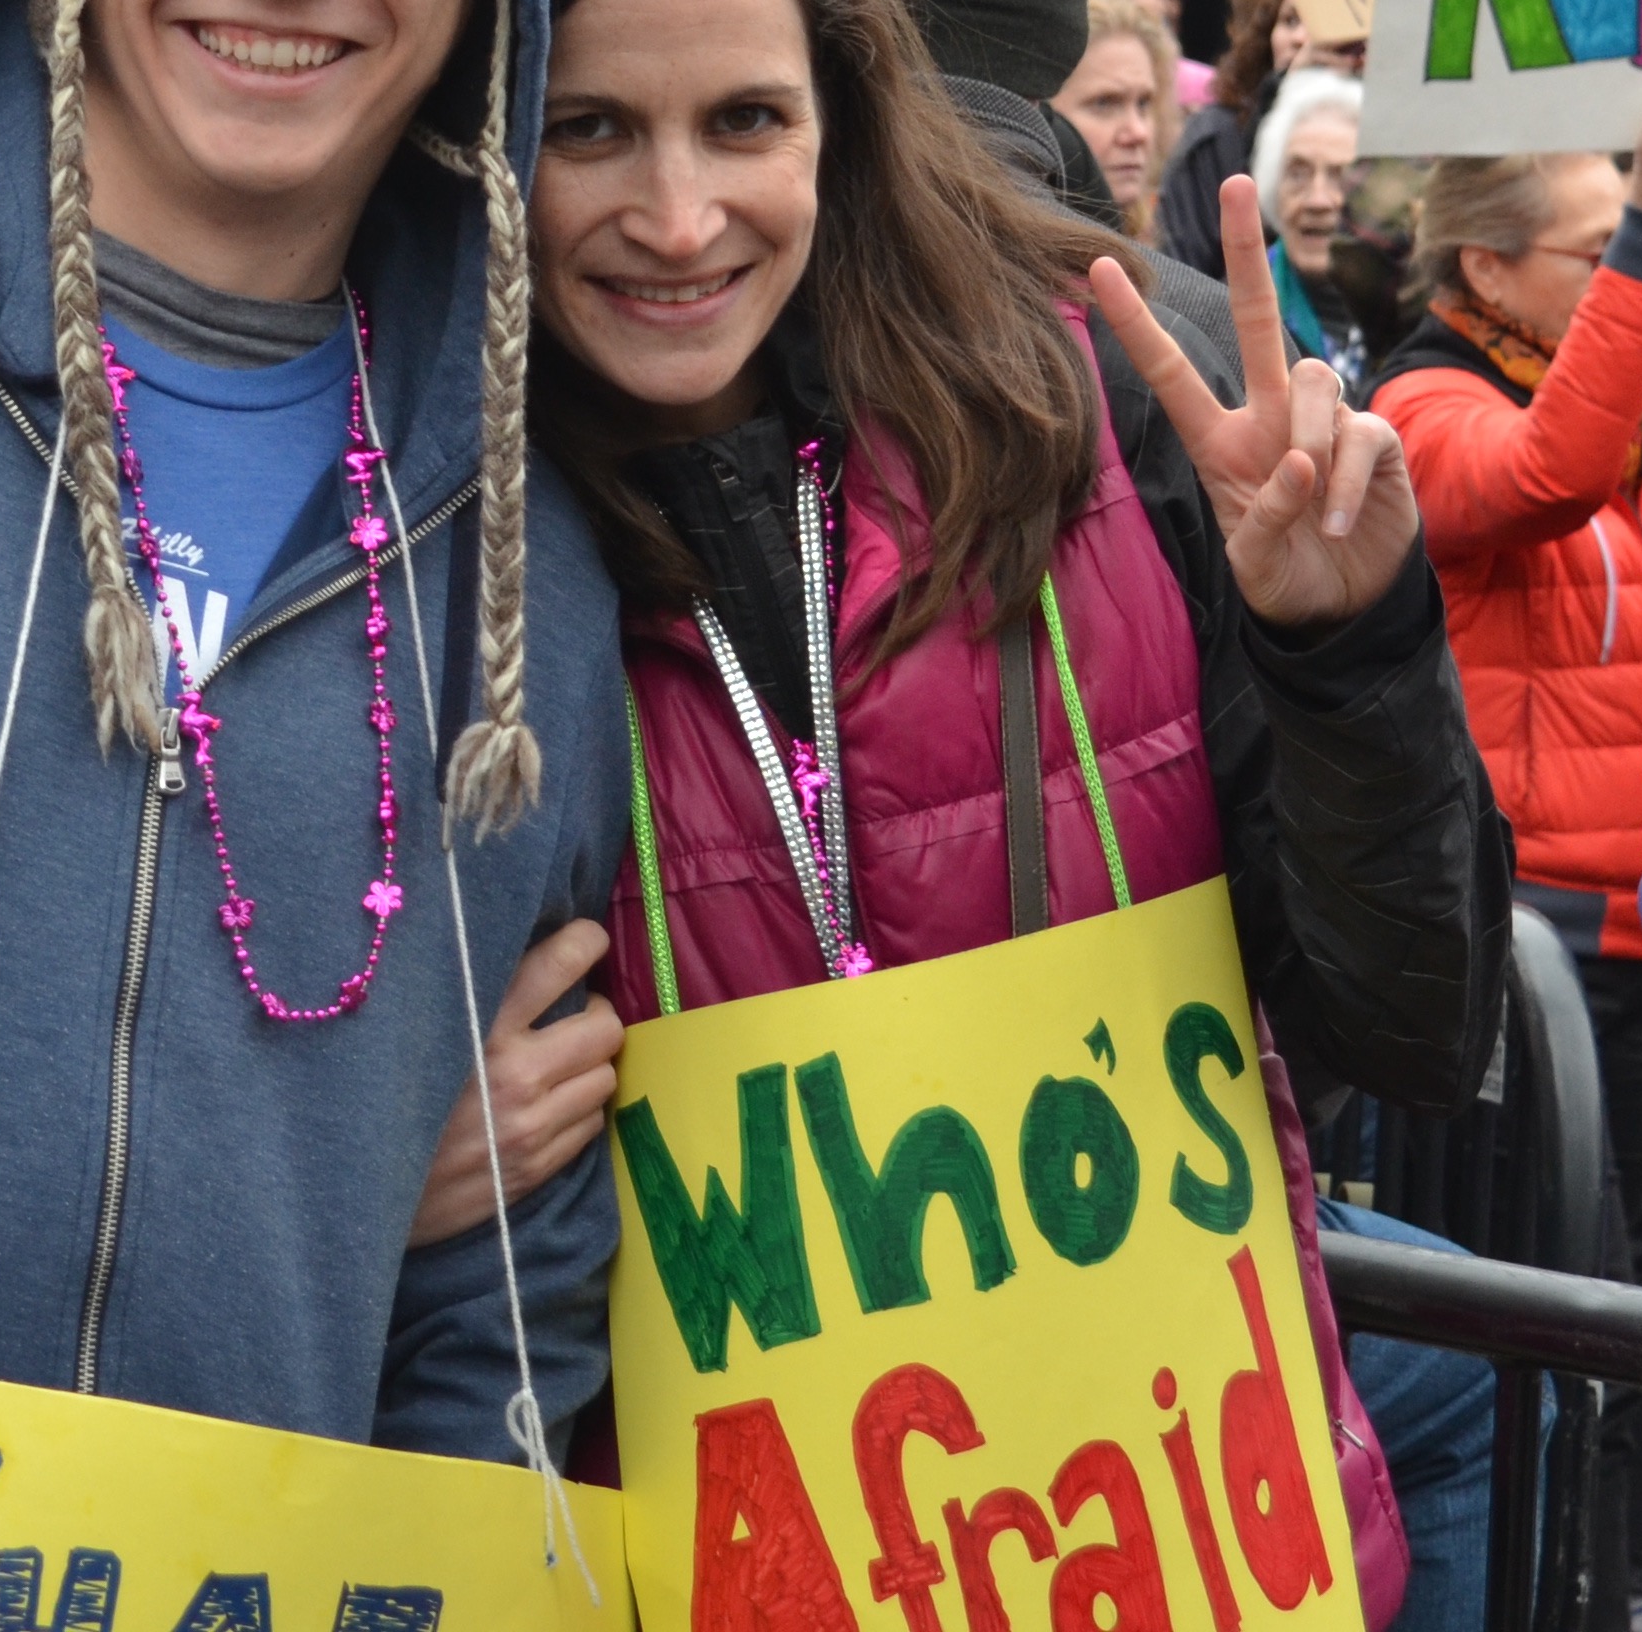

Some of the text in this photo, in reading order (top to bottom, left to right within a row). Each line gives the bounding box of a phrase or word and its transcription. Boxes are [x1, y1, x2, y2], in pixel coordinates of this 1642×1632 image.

[121, 517, 205, 567] Pilly
[615, 1000, 1254, 1372] Who's
[690, 1243, 1334, 1632] Afraid
